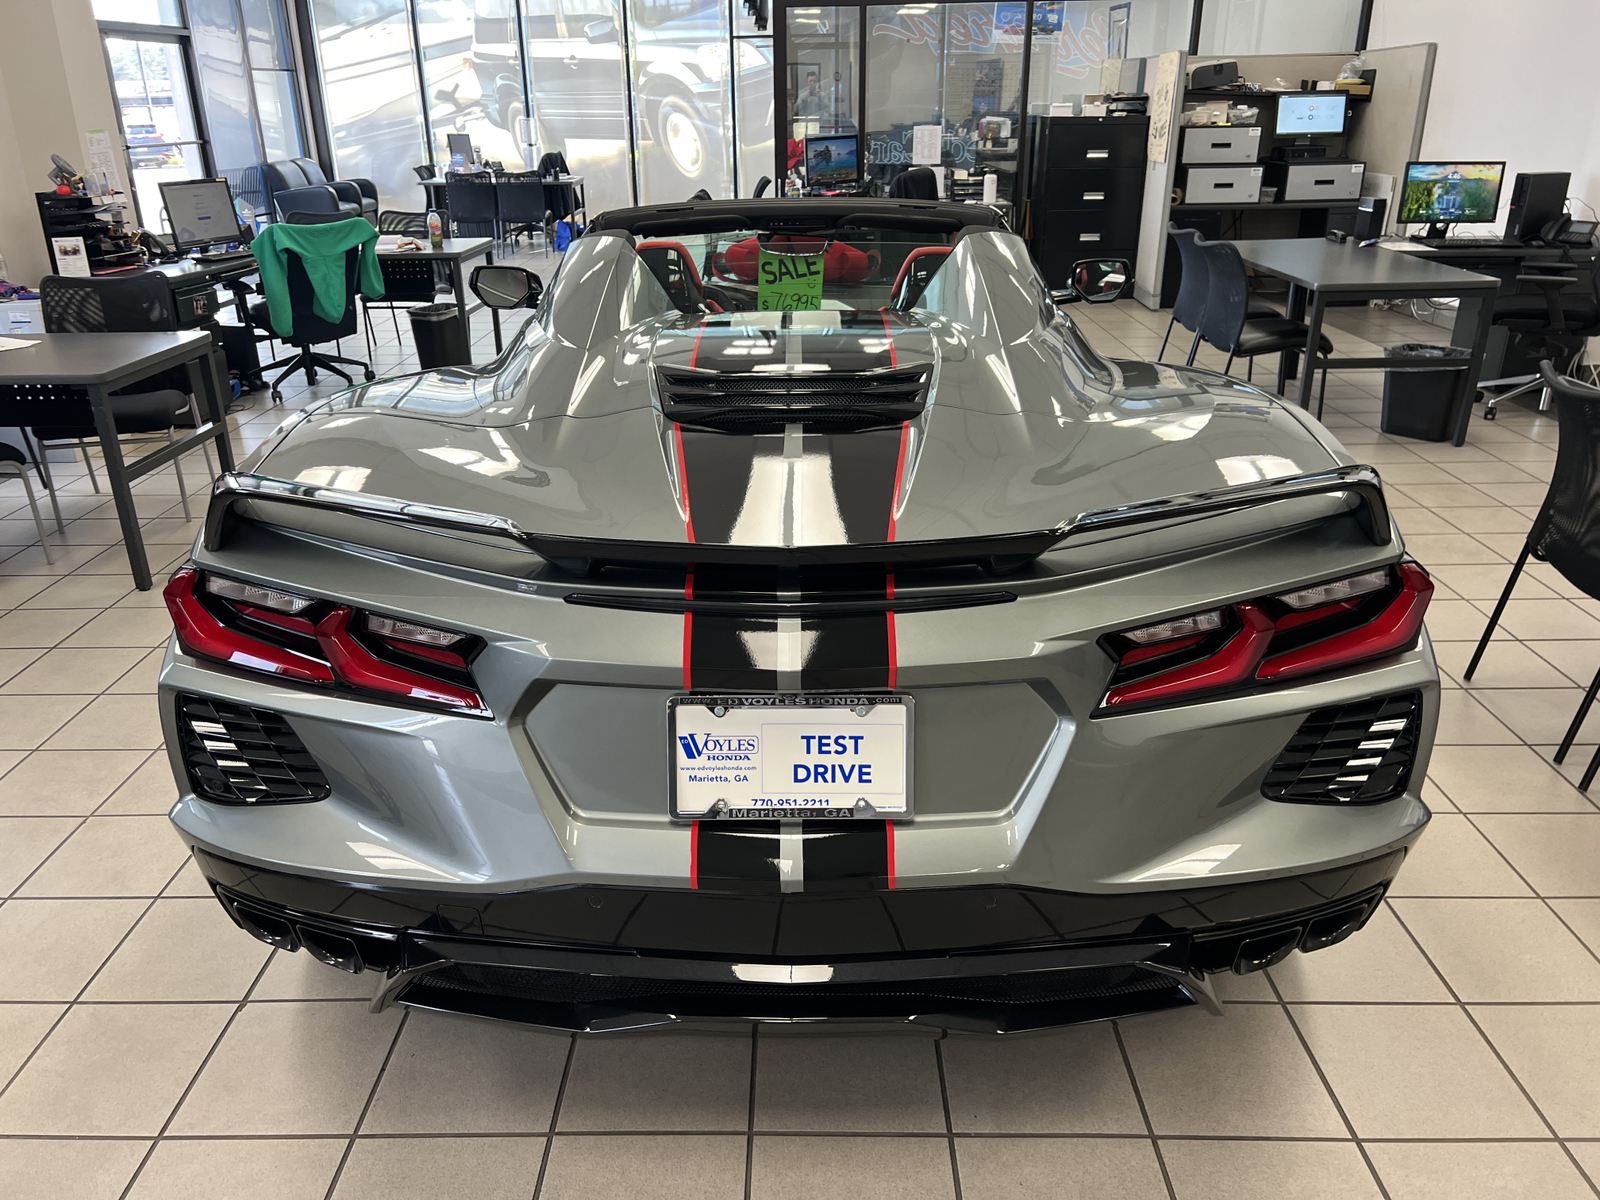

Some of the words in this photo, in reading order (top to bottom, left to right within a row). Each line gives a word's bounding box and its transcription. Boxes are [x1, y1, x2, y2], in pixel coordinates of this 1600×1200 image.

[761, 255, 820, 285] SALE
[801, 735, 864, 755] TEST
[688, 774, 731, 784] Marietta,
[734, 774, 749, 783] GA
[793, 764, 873, 784] DRIVE
[751, 798, 830, 807] 770-951-2211
[732, 808, 818, 819] Marietta,
[824, 808, 851, 818] GA
